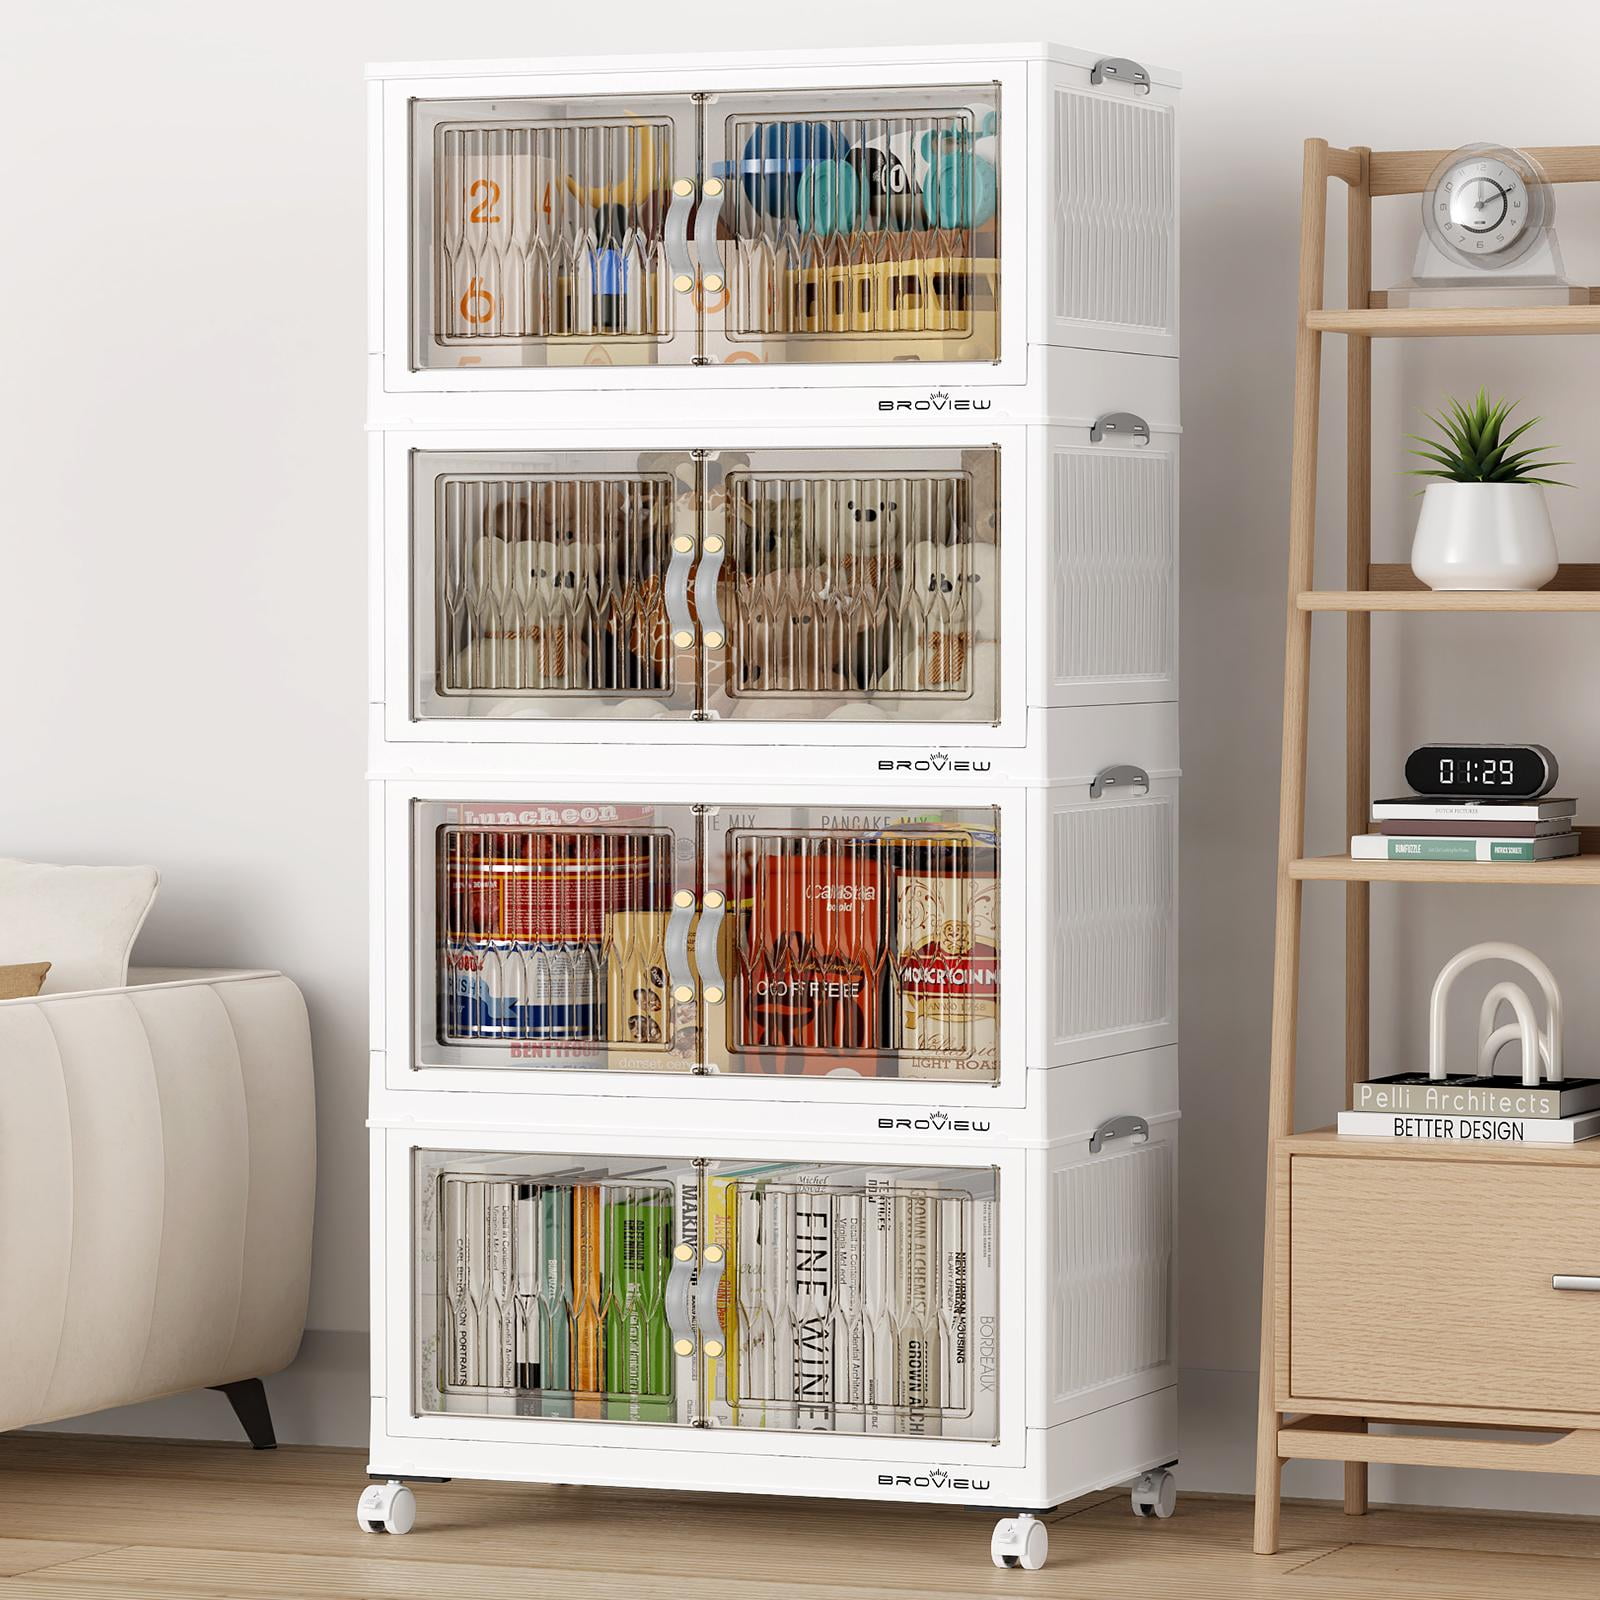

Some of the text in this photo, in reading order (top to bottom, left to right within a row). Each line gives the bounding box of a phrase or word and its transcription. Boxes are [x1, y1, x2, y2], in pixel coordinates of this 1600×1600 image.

[469, 179, 501, 224] 2
[460, 277, 497, 324] 6
[878, 396, 991, 411] BROVIEW
[878, 756, 991, 772] BROVIEW
[1439, 759, 1514, 785] 01:29
[822, 815, 891, 831] PANCAKE
[1361, 1085, 1550, 1114] Pelli Architects
[878, 1115, 990, 1132] BROVIEW
[1394, 1117, 1524, 1141] BETTER DESIGN
[682, 1184, 698, 1258] MAKIN
[796, 1212, 828, 1297] FINE
[955, 1251, 966, 1276] NEW
[459, 1330, 468, 1386] PORTRAITS
[908, 1340, 922, 1392] GROWN
[980, 1316, 995, 1393] BORDEAUX
[878, 1472, 990, 1490] BROVIEW
